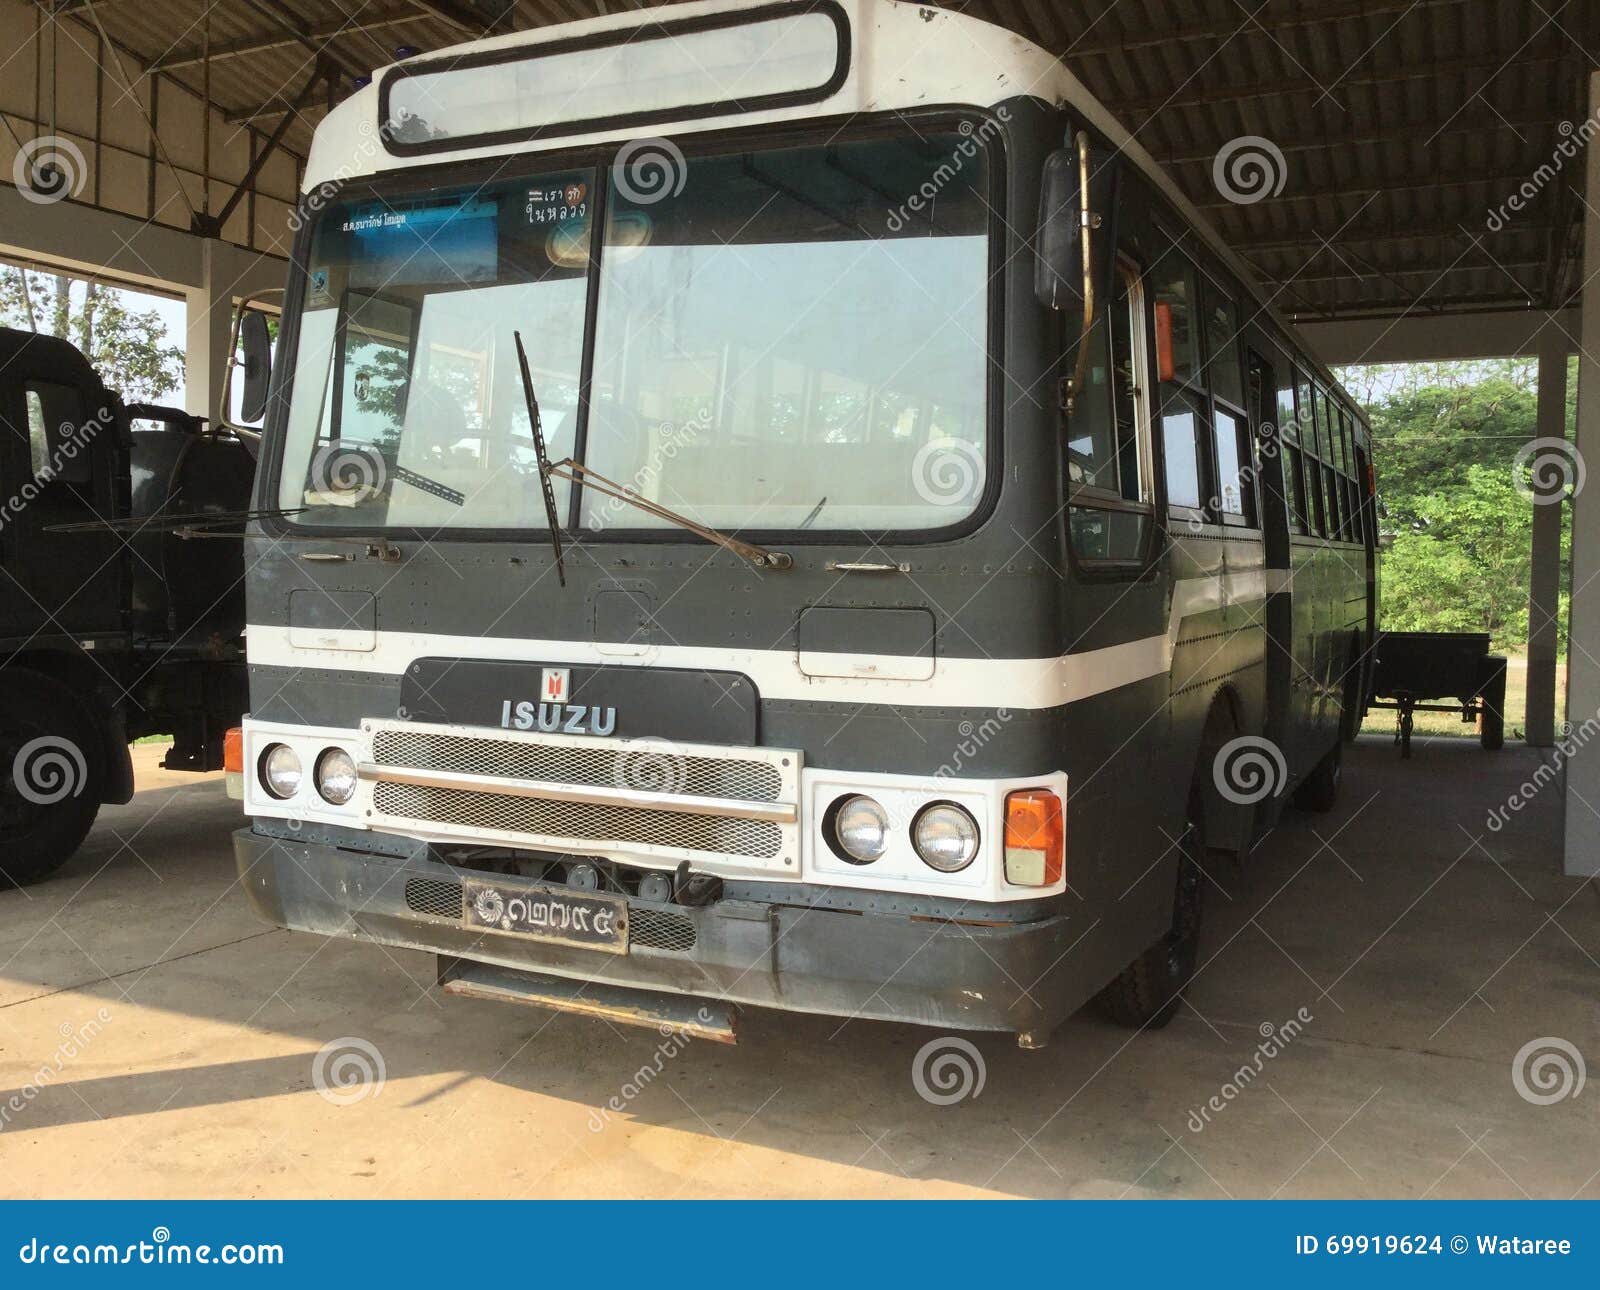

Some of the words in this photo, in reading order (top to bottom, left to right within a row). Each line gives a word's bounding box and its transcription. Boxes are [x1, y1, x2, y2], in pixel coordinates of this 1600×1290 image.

[544, 190, 563, 201] เรา
[525, 203, 586, 223] ในหลวง
[501, 700, 616, 737] ISUZU
